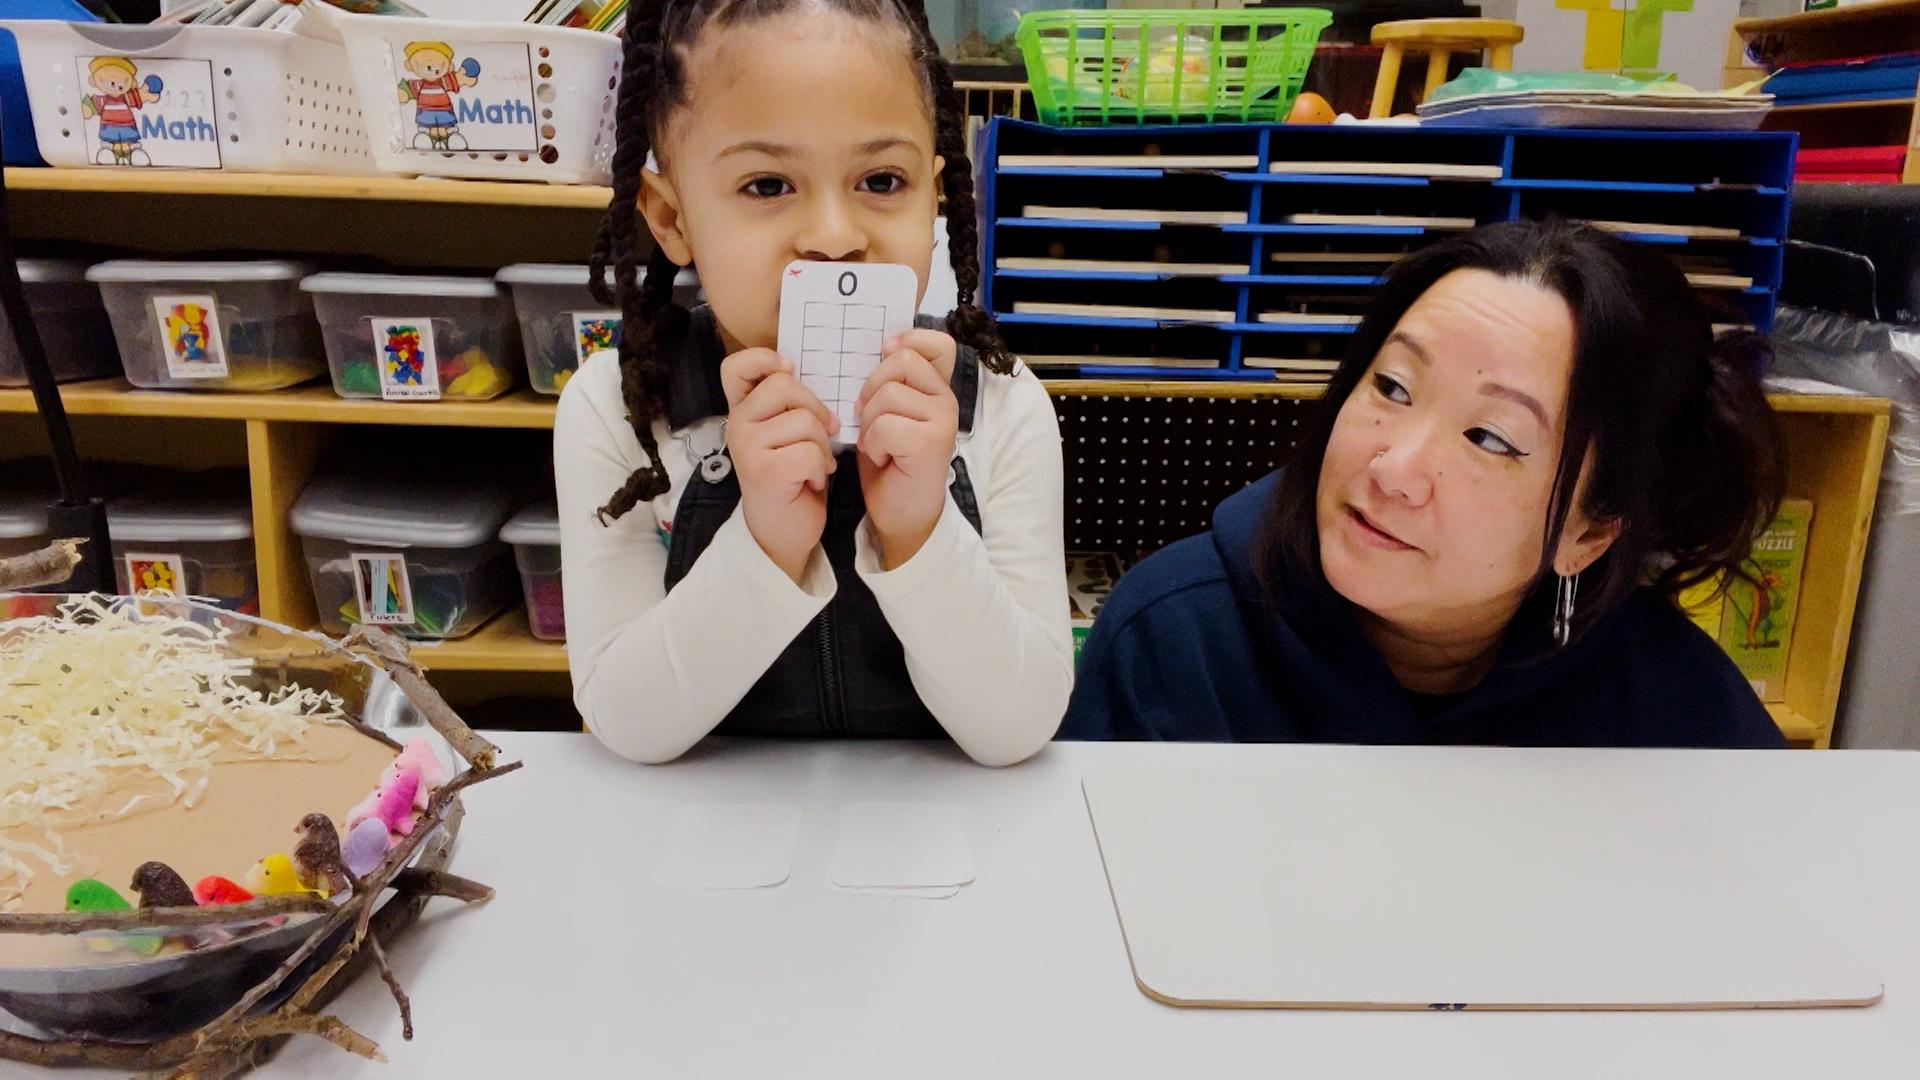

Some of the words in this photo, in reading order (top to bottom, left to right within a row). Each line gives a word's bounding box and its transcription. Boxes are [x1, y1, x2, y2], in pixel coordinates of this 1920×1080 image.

[458, 97, 533, 124] Math
[142, 113, 215, 141] Math
[838, 271, 858, 297] 0
